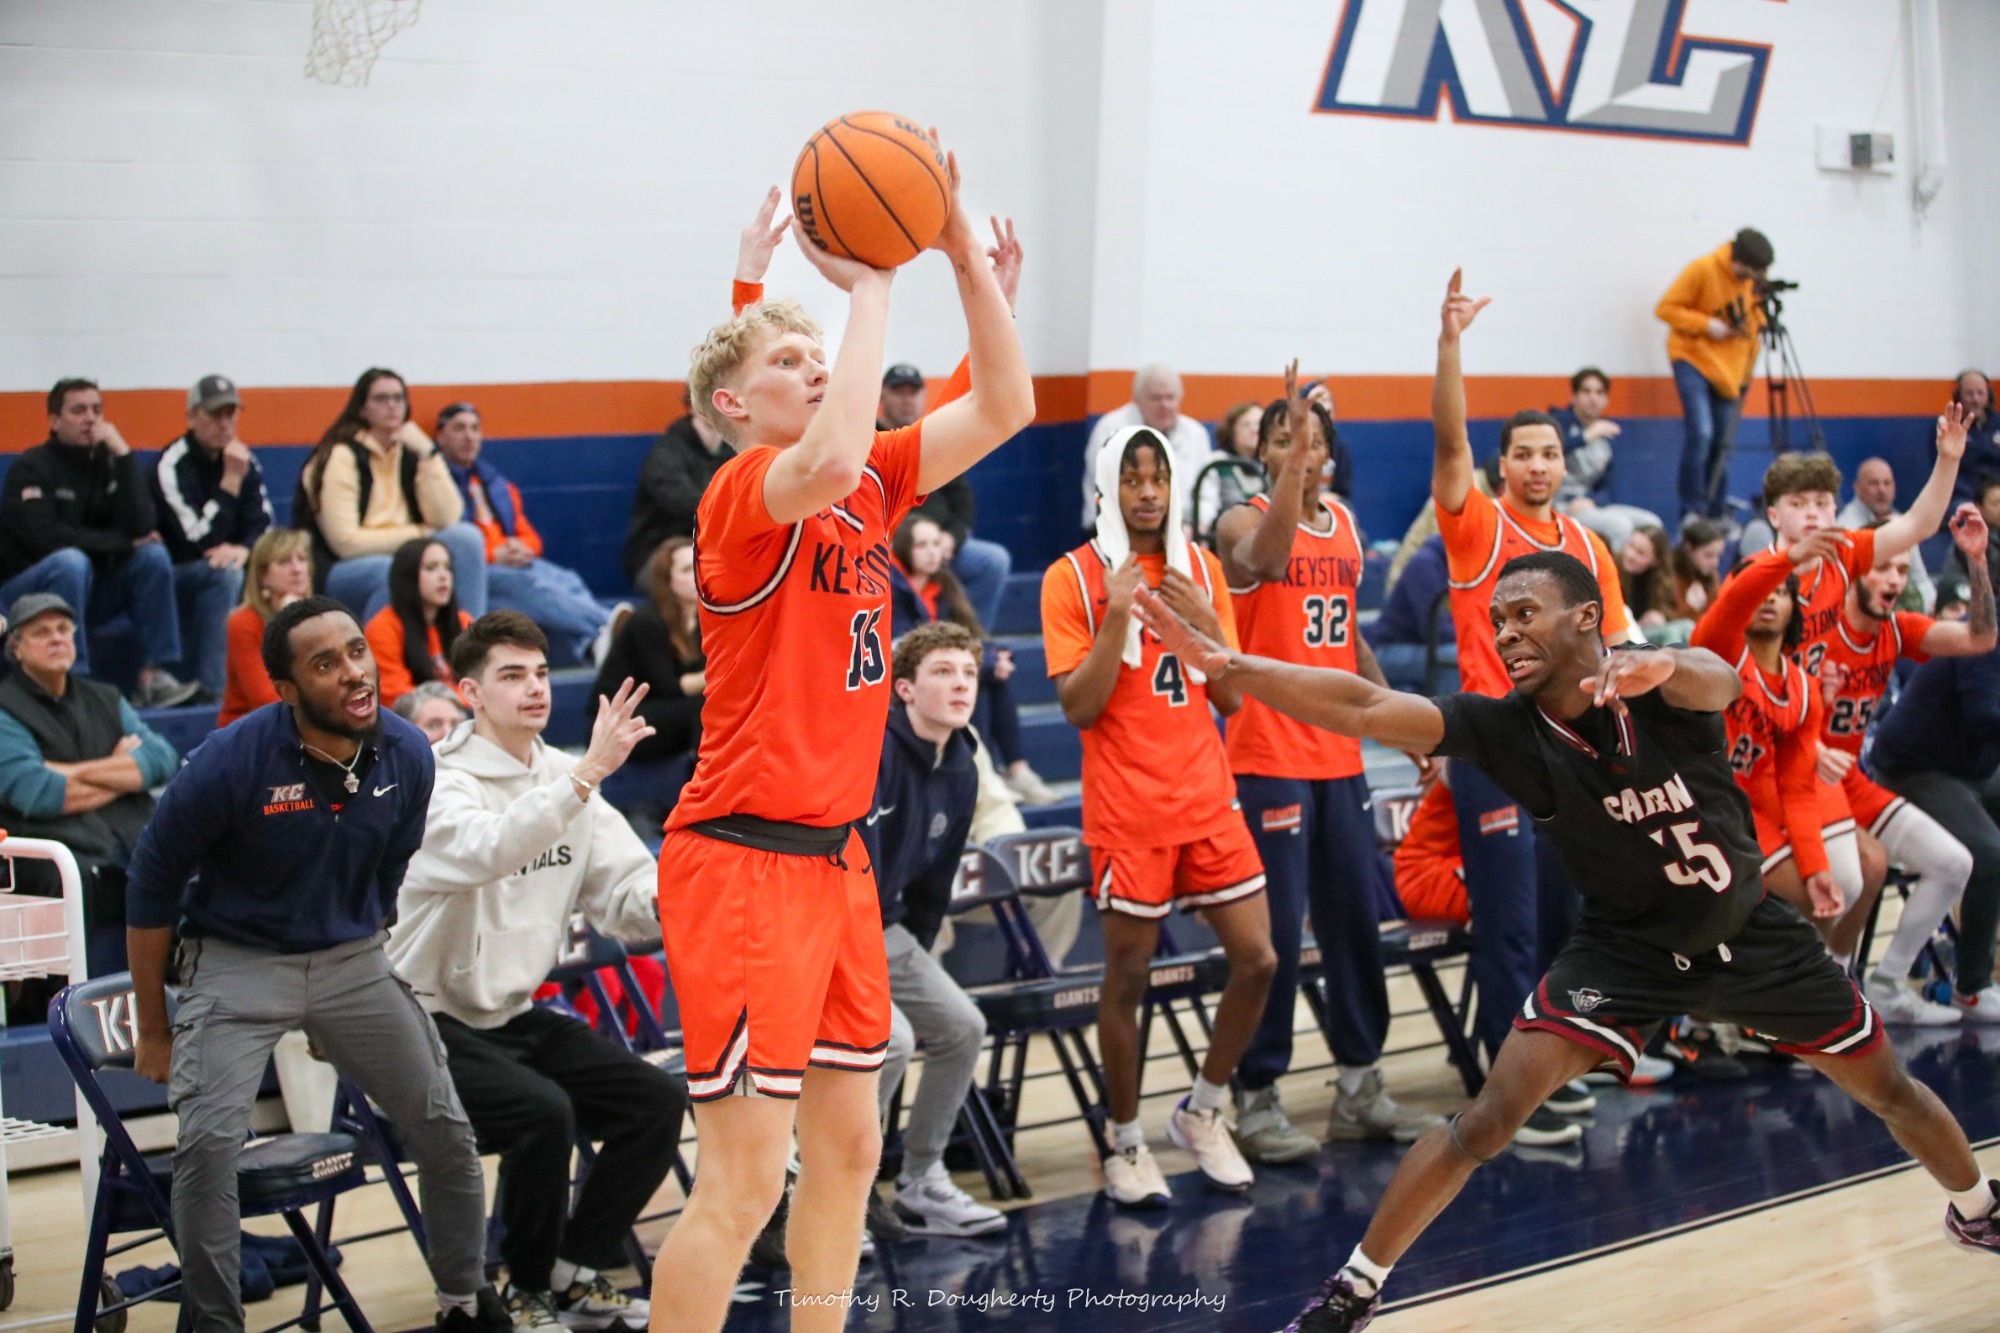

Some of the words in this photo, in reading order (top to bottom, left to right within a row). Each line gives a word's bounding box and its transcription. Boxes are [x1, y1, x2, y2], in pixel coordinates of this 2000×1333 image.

[1303, 595, 1350, 648] 32
[846, 604, 886, 691] 15
[1153, 653, 1188, 707] 4
[1827, 696, 1876, 736] 25
[263, 799, 315, 816] BASKETBALL
[268, 782, 306, 803] KC
[1016, 839, 1082, 888] KC
[1054, 986, 1099, 1009] GIANTS
